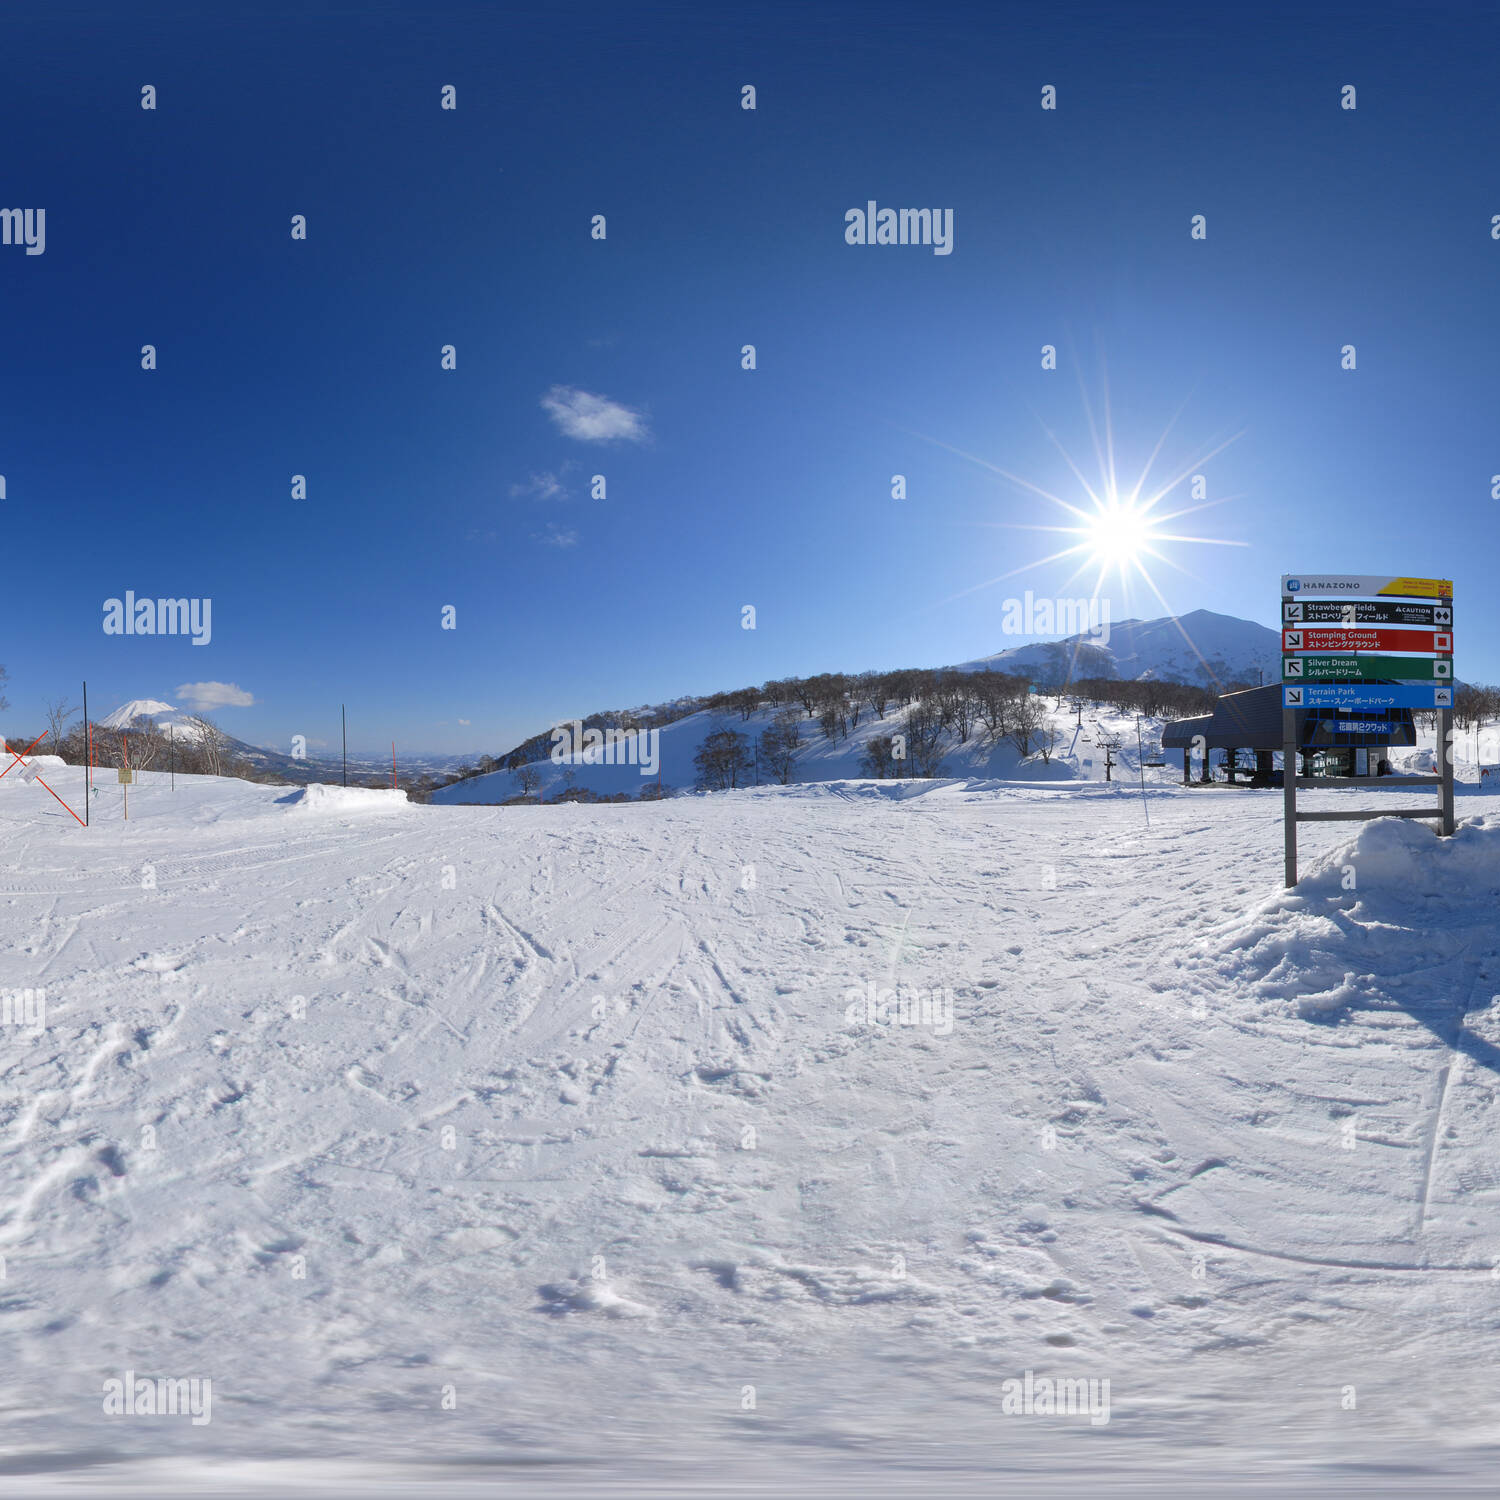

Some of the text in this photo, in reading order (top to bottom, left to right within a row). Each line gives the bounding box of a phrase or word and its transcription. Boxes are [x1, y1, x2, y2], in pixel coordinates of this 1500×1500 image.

[1354, 604, 1376, 612] Fields
[1308, 632, 1377, 640] Stomping Ground
[1308, 659, 1330, 667] Silver
